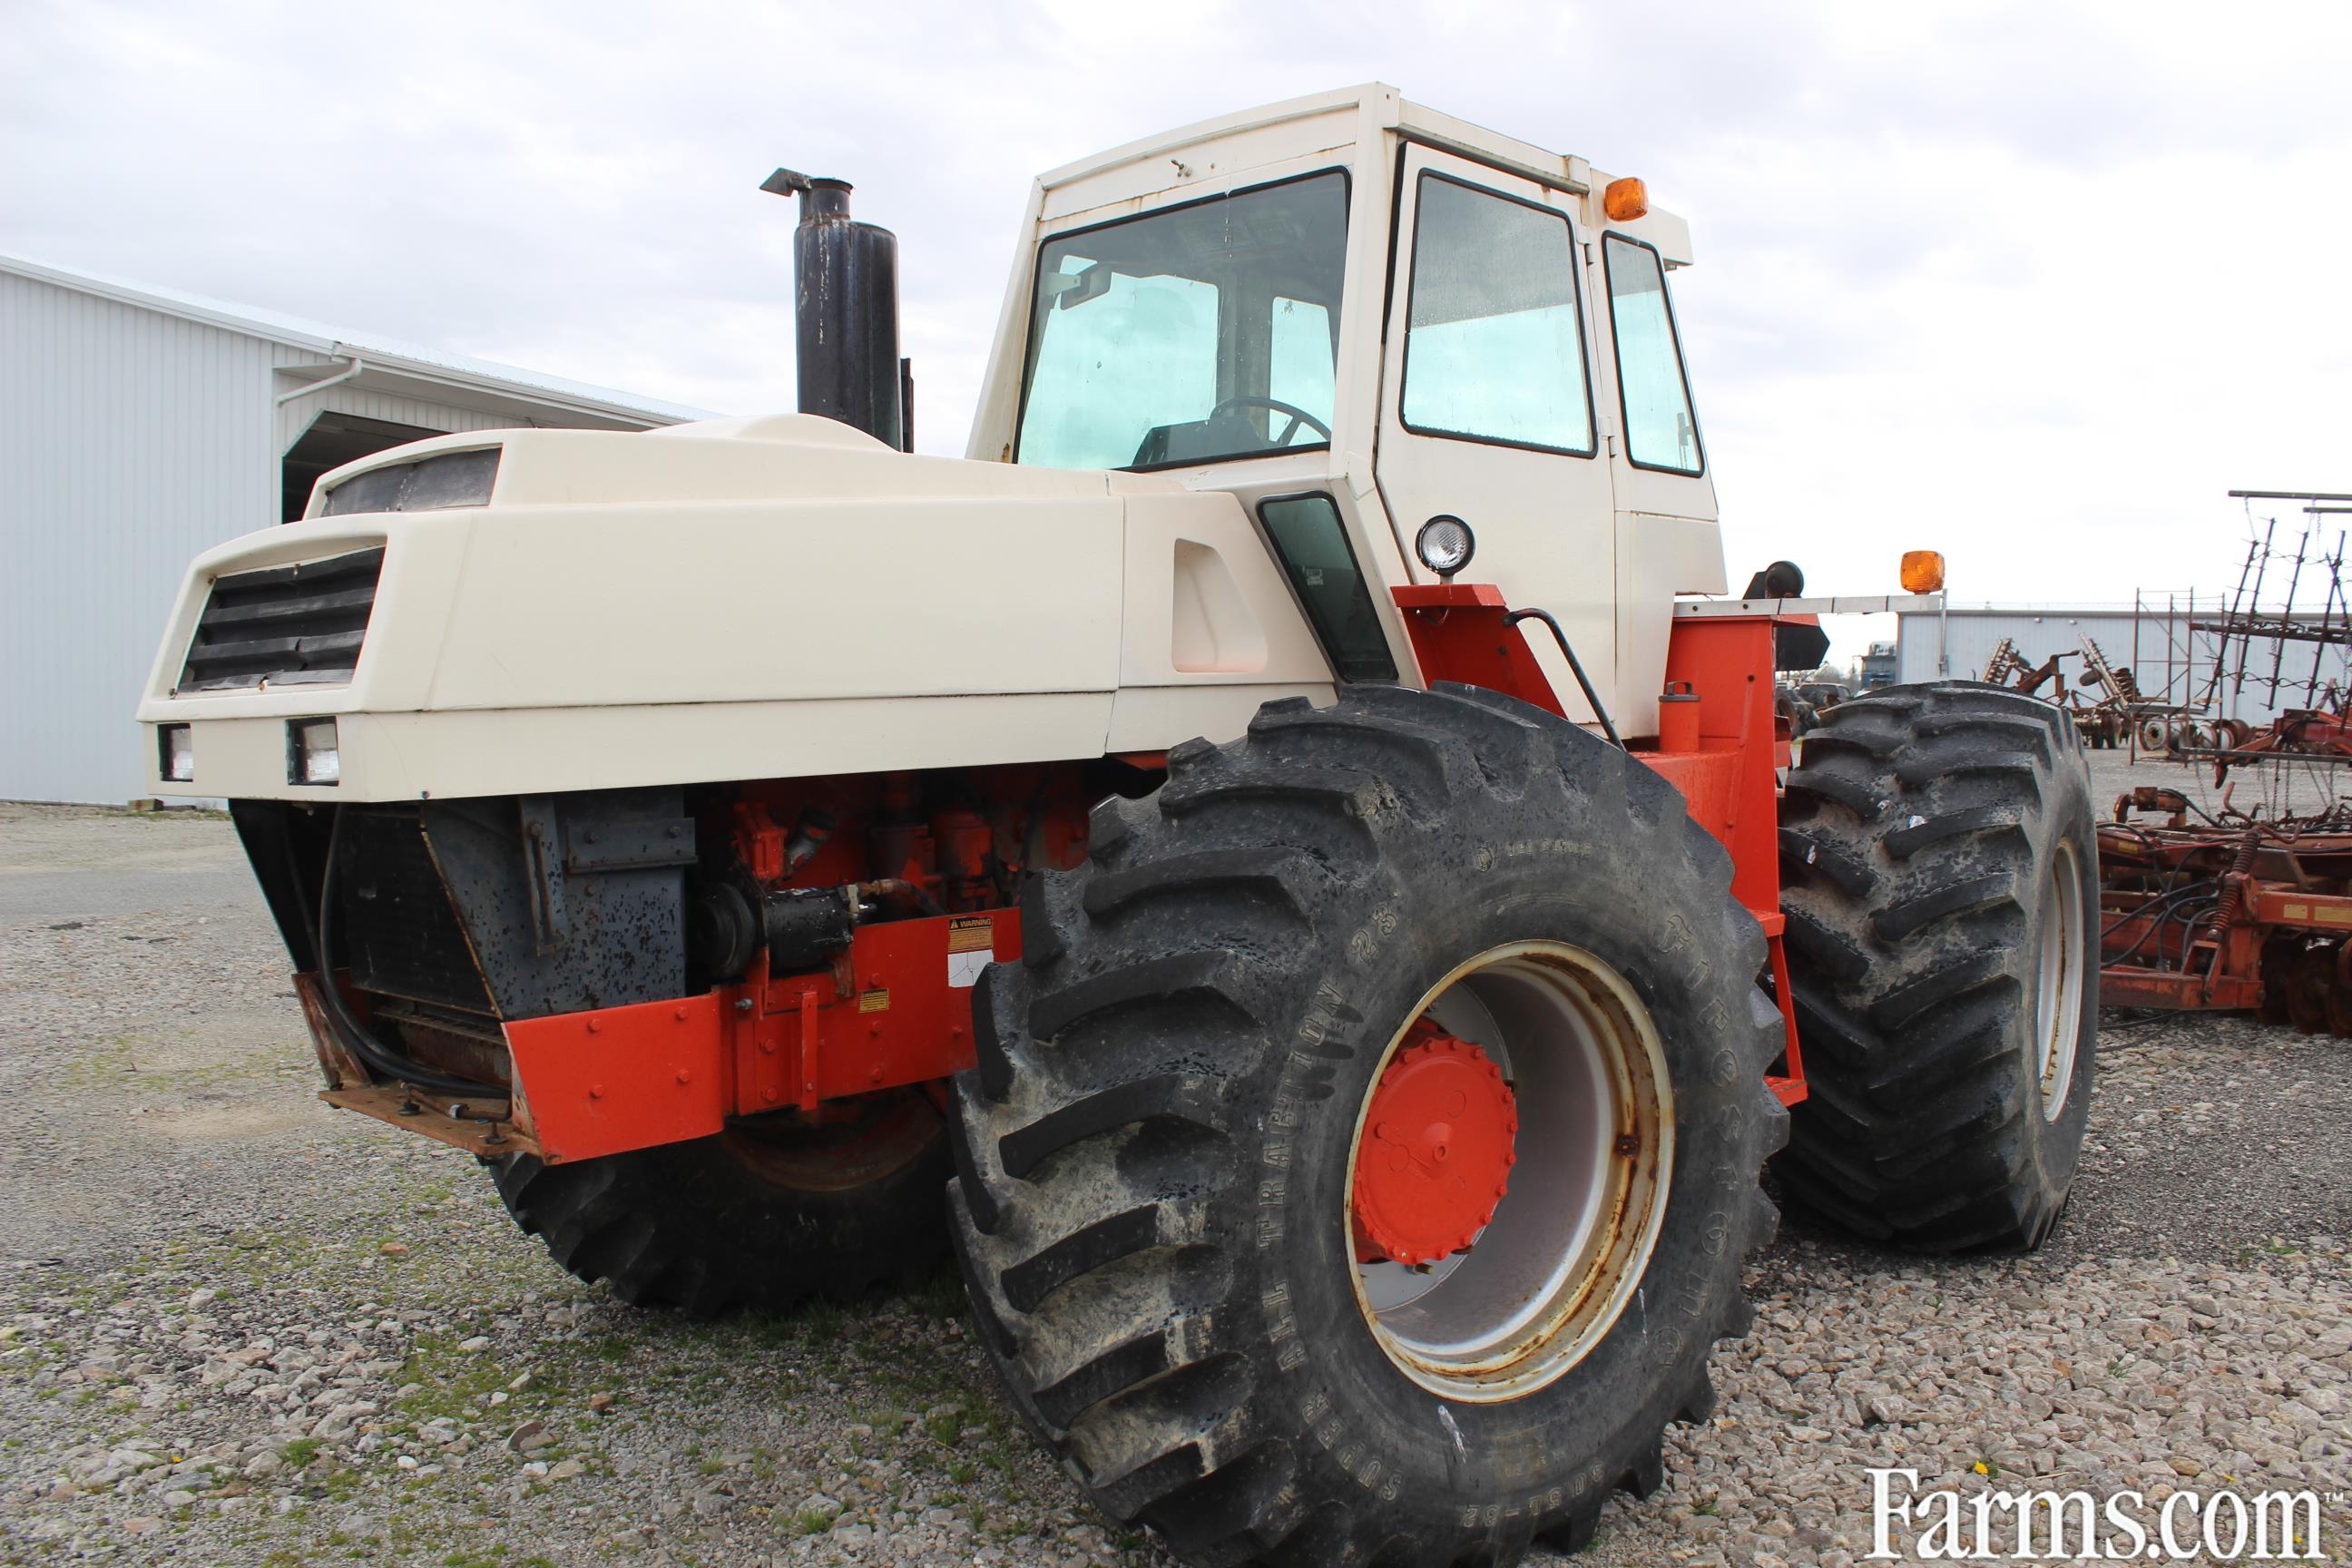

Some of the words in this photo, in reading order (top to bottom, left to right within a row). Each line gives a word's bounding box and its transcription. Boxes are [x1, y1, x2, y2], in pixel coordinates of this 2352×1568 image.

[960, 918, 991, 927] WARNING
[1349, 902, 1398, 965] 23
[1258, 980, 1344, 1249] TRACTION
[1261, 1280, 1308, 1371] ALL
[1301, 1392, 1403, 1501] SUPER
